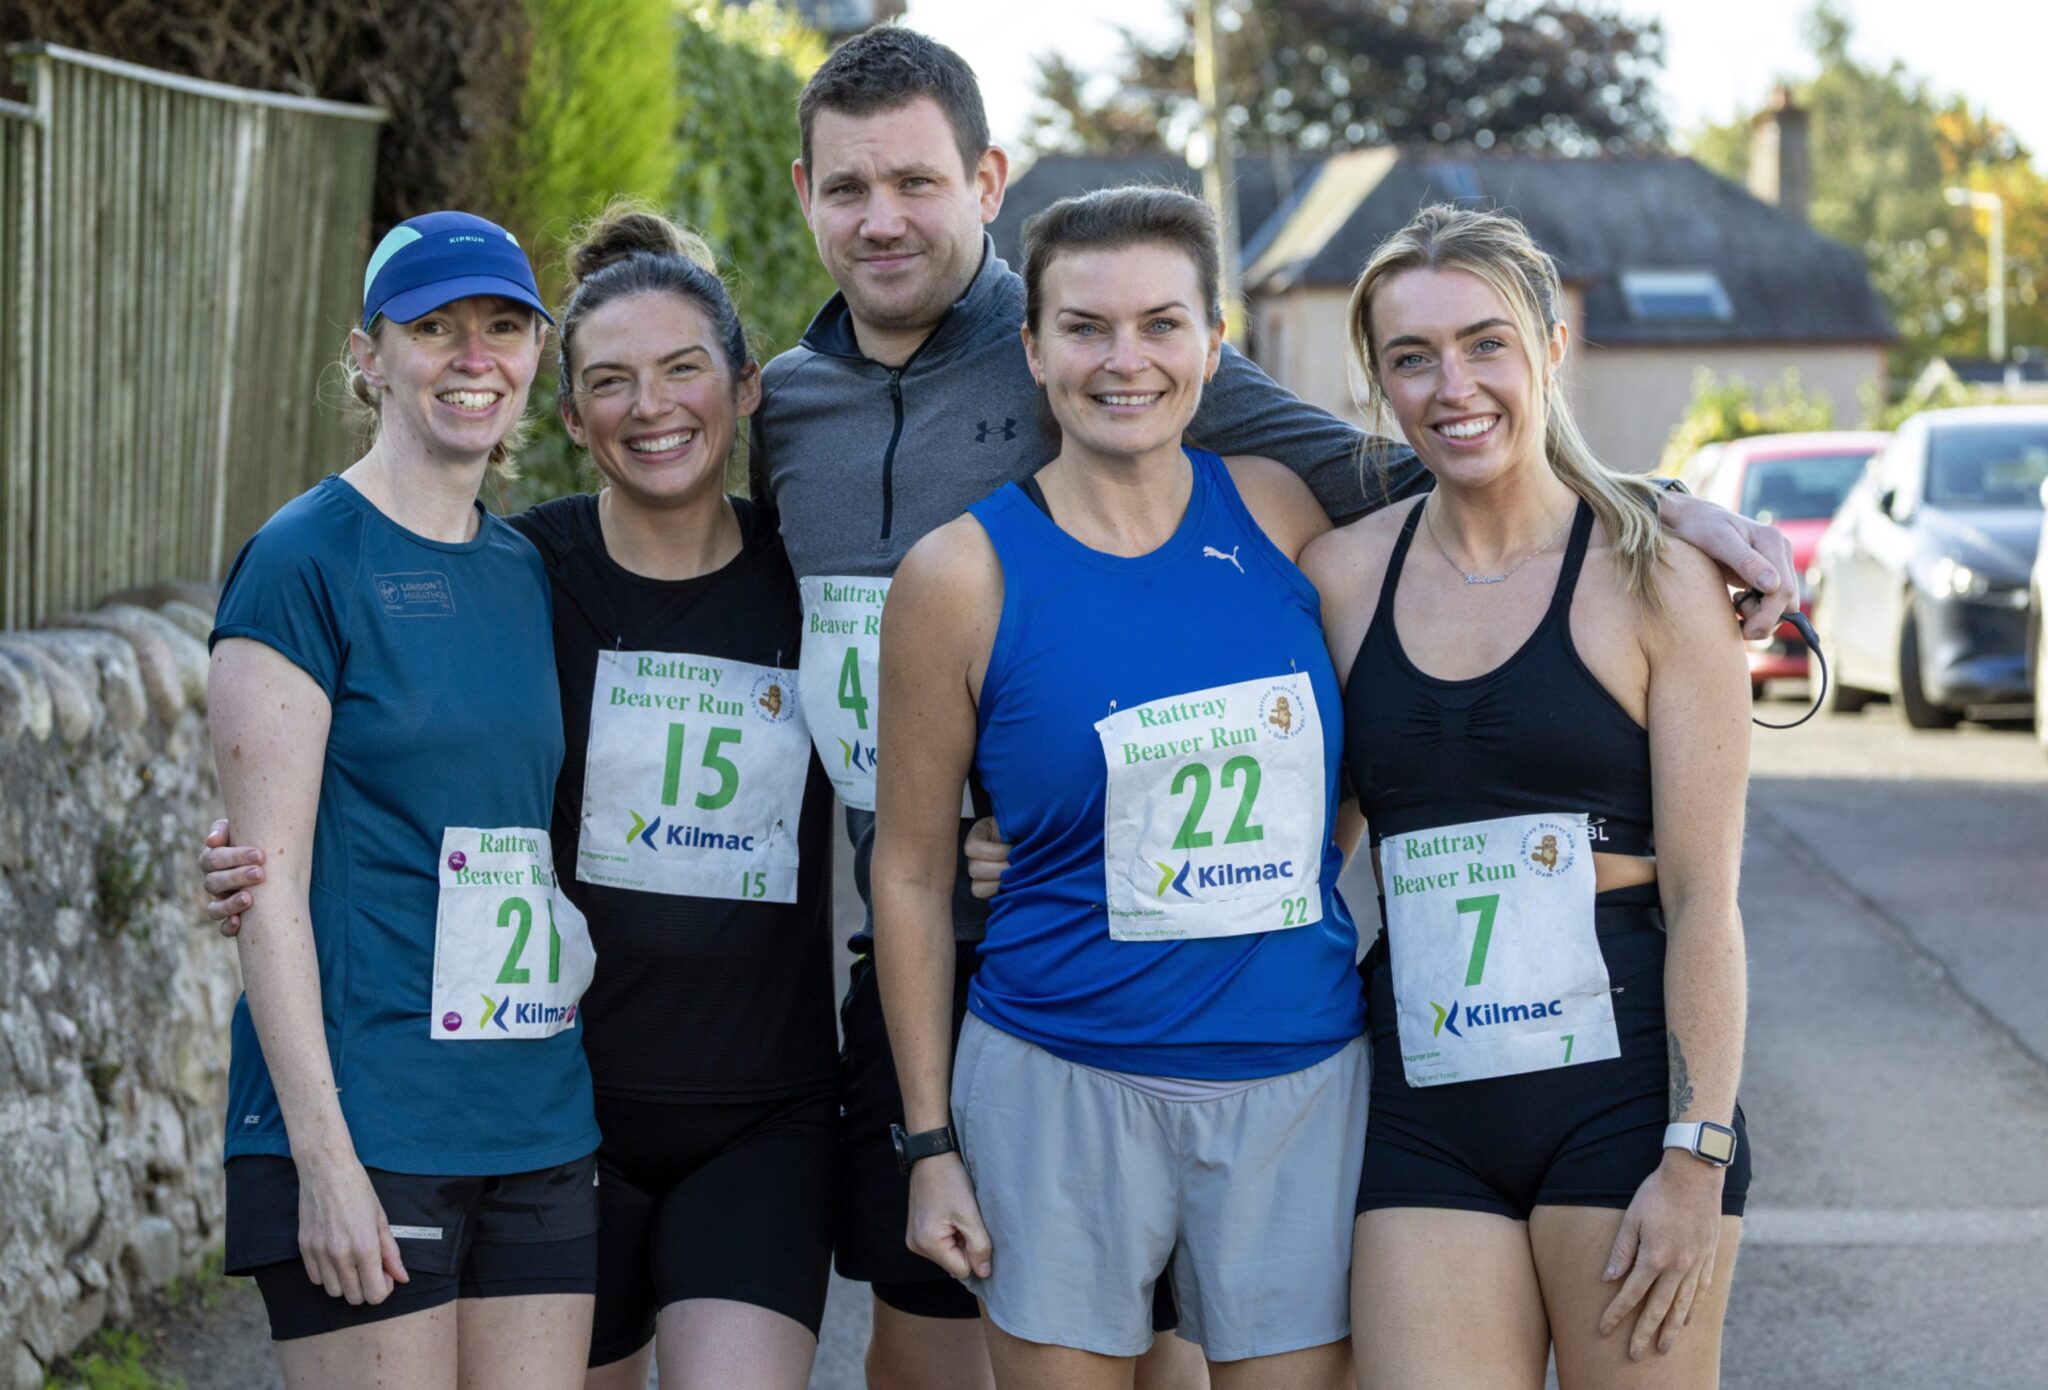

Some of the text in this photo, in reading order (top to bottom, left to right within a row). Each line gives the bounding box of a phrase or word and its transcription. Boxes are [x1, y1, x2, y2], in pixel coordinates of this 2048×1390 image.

[449, 236, 485, 244] KIPRUN
[823, 581, 887, 608] Rattray
[809, 612, 858, 635] Beaver
[636, 656, 724, 687] Rattray
[608, 686, 744, 717] Beaver Run
[837, 646, 869, 730] 4
[1136, 697, 1227, 729] Rattray
[1121, 726, 1258, 766] Beaver Run
[660, 721, 743, 811] 15
[1169, 755, 1264, 851] 22
[479, 832, 539, 858] Rattray
[666, 824, 755, 852] Kilmac
[1405, 832, 1488, 860] Rattray
[455, 864, 525, 886] Beaver
[742, 871, 767, 899] 15
[1198, 860, 1294, 889] Kilmac
[1393, 861, 1517, 897] Beaver Run
[1281, 896, 1308, 927] 22
[495, 896, 561, 984] 21
[1455, 893, 1501, 988] 7
[515, 1002, 568, 1025] Kilma
[1465, 999, 1563, 1028] Kilmac
[1559, 1034, 1575, 1064] 7
